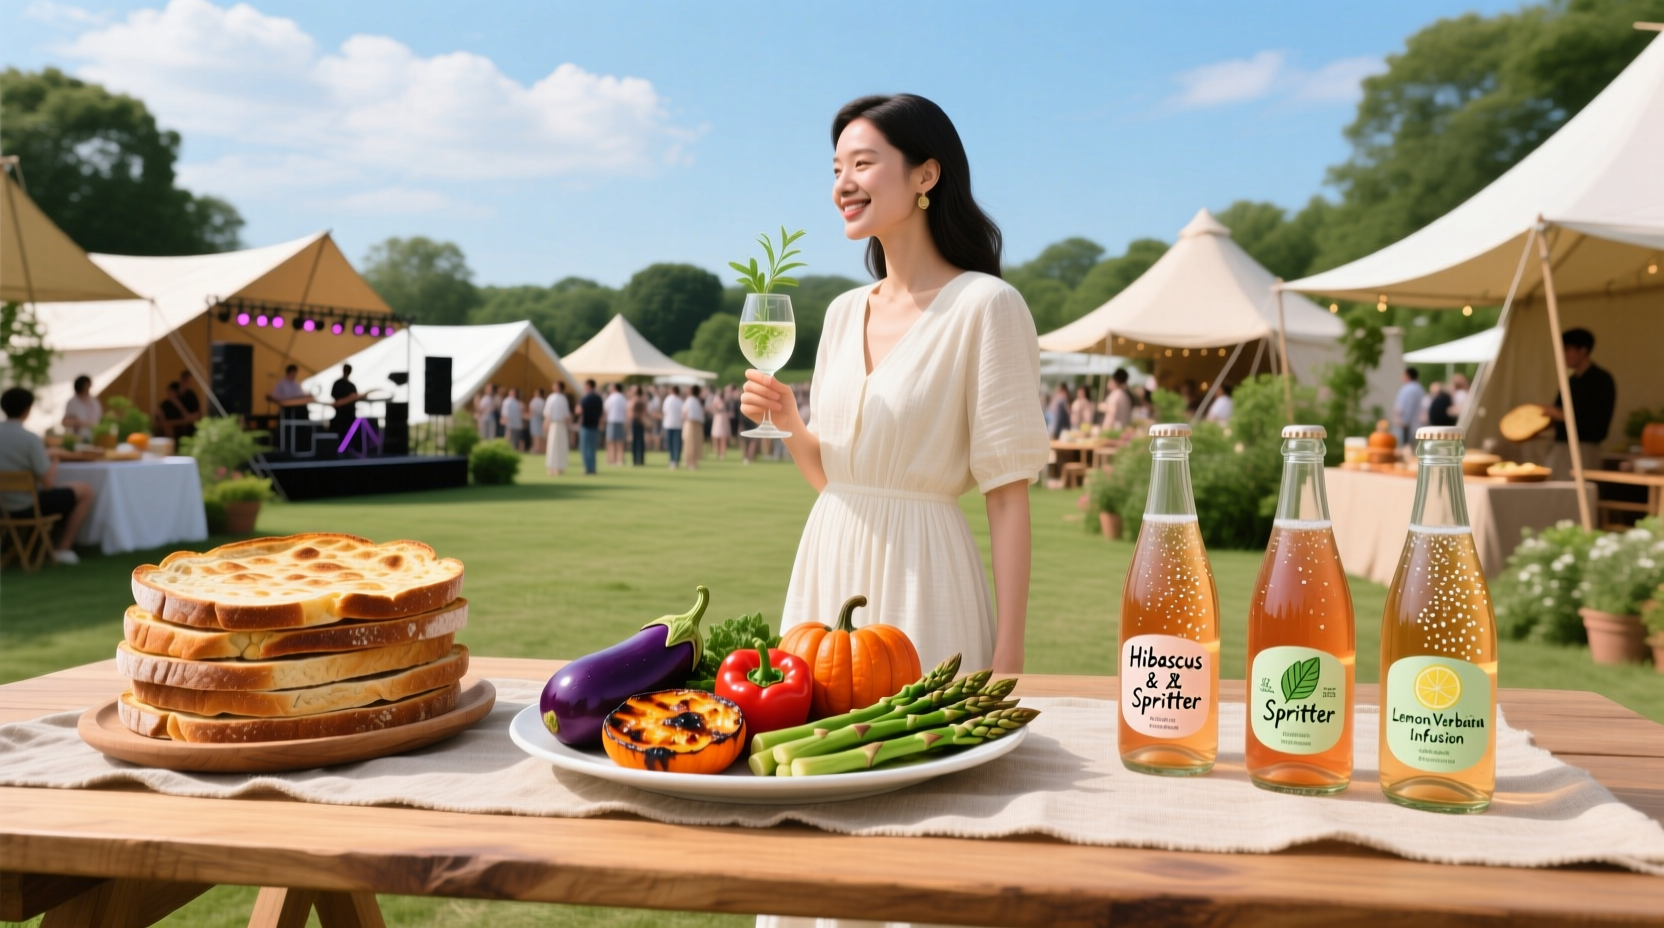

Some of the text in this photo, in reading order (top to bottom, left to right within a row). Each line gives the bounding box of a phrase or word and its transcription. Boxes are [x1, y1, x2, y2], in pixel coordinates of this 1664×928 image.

[1146, 671, 1158, 689] &
[1131, 687, 1202, 715] Spritter
[1263, 699, 1336, 729] Spritter
[1392, 707, 1431, 726] Lemon
[1410, 728, 1464, 745] Infusion
